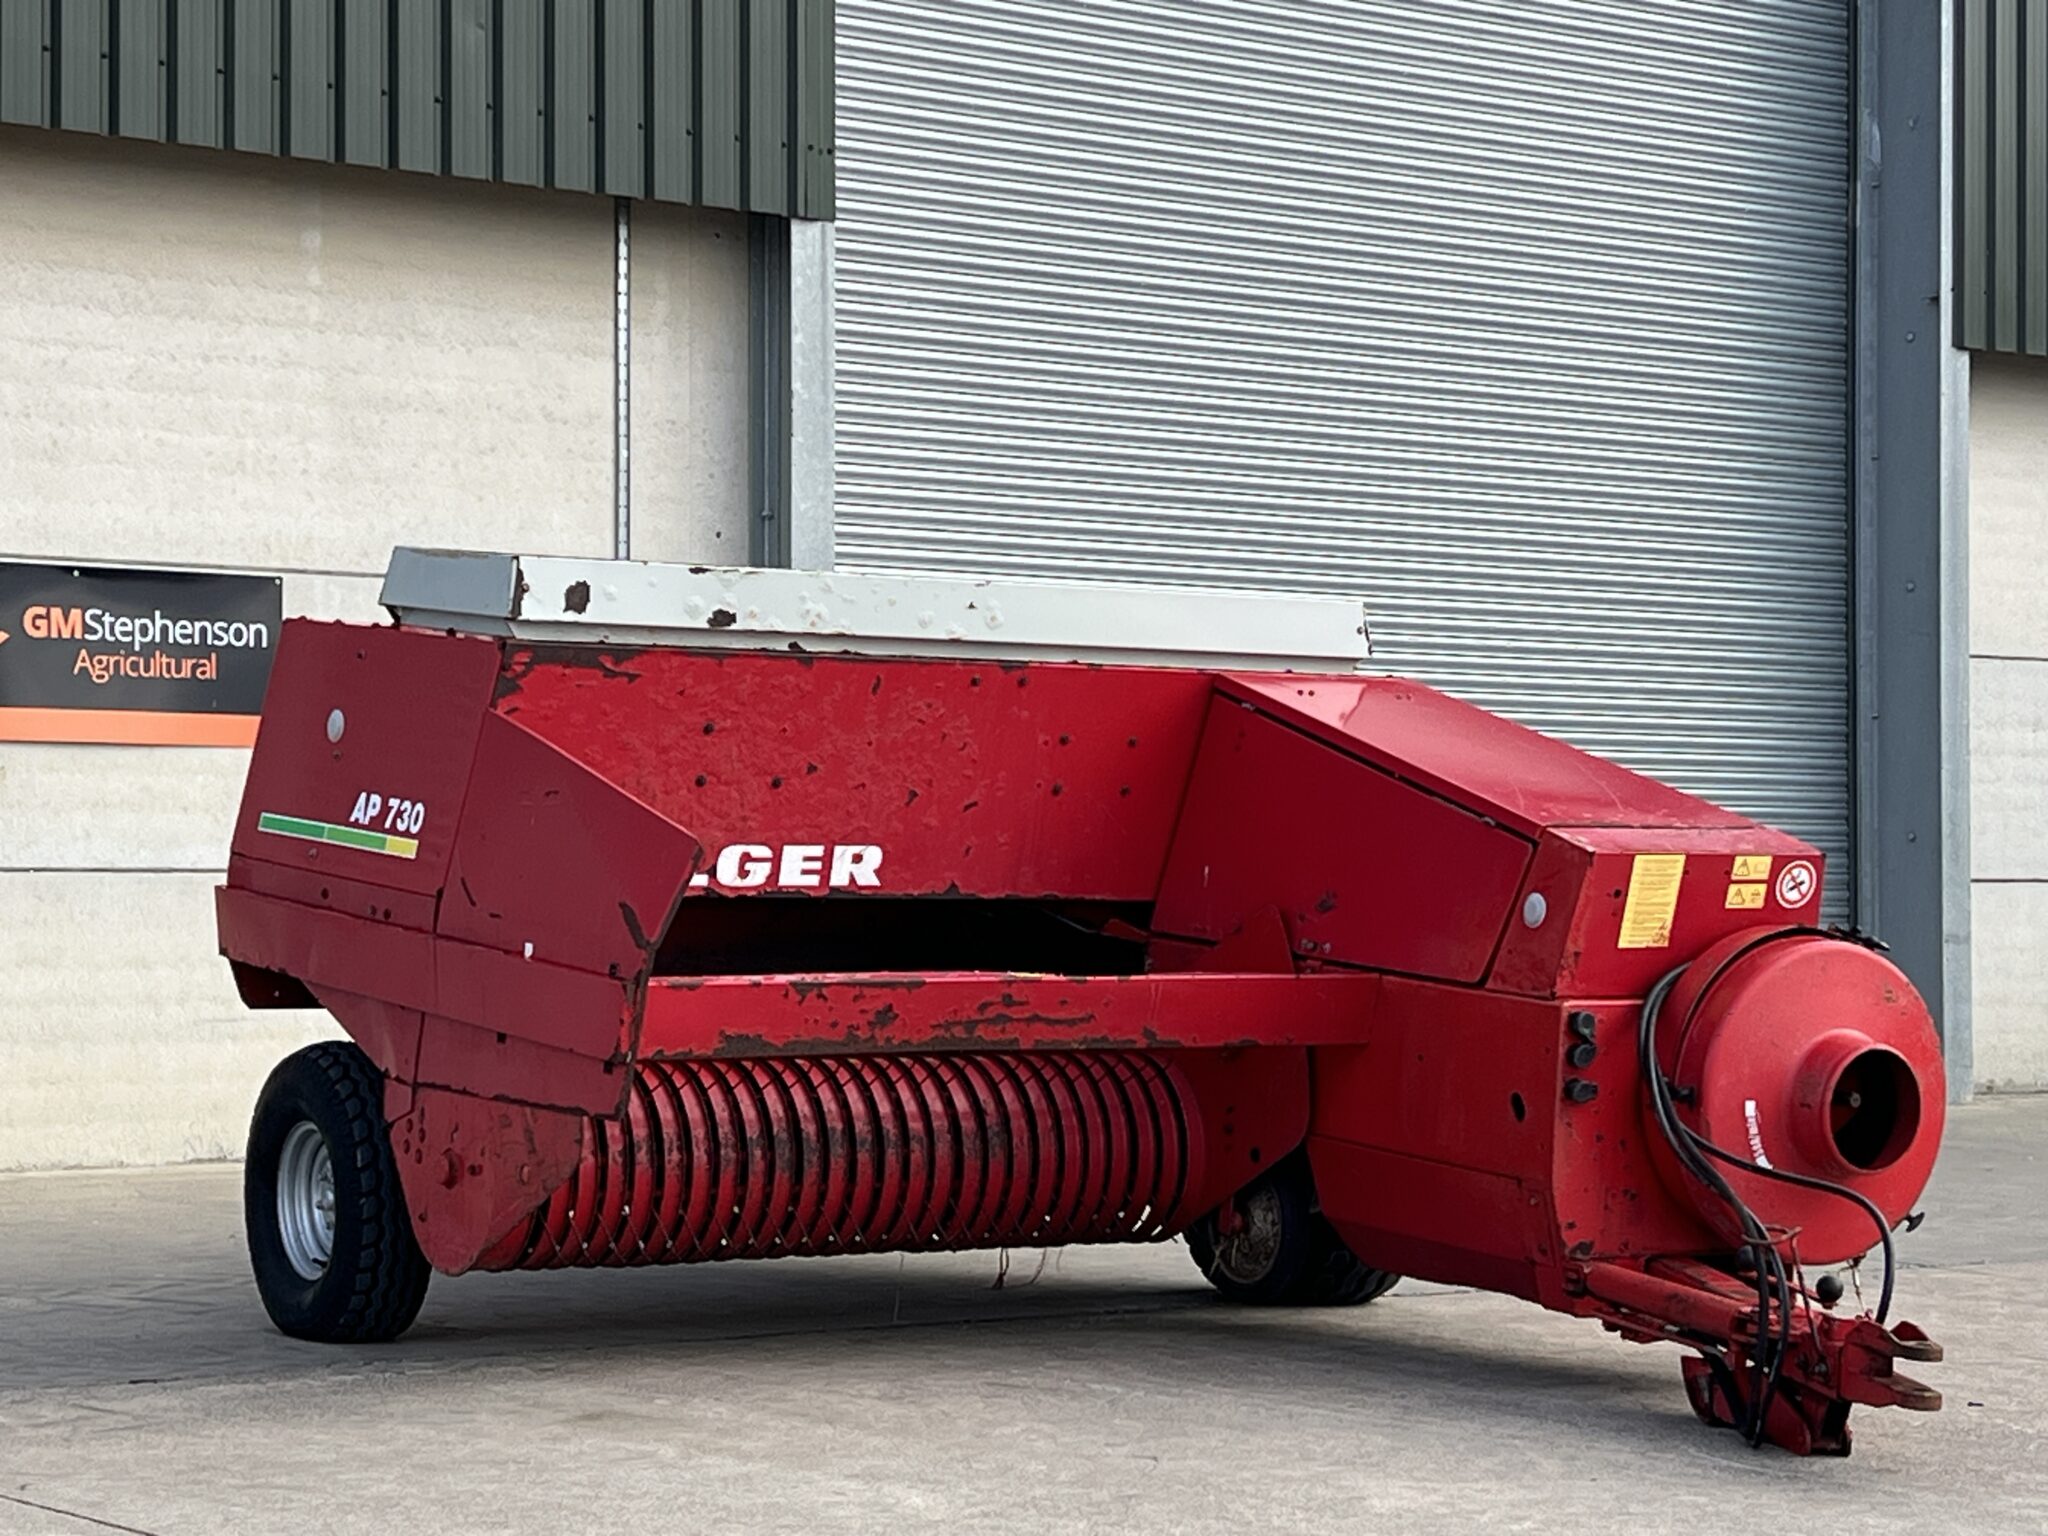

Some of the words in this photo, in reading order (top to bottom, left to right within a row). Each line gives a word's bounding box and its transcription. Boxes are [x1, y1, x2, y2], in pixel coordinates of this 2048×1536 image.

[22, 605, 269, 652] GMStephenson
[73, 648, 218, 684] Agricultural
[349, 791, 382, 825] AP
[384, 797, 424, 834] 730
